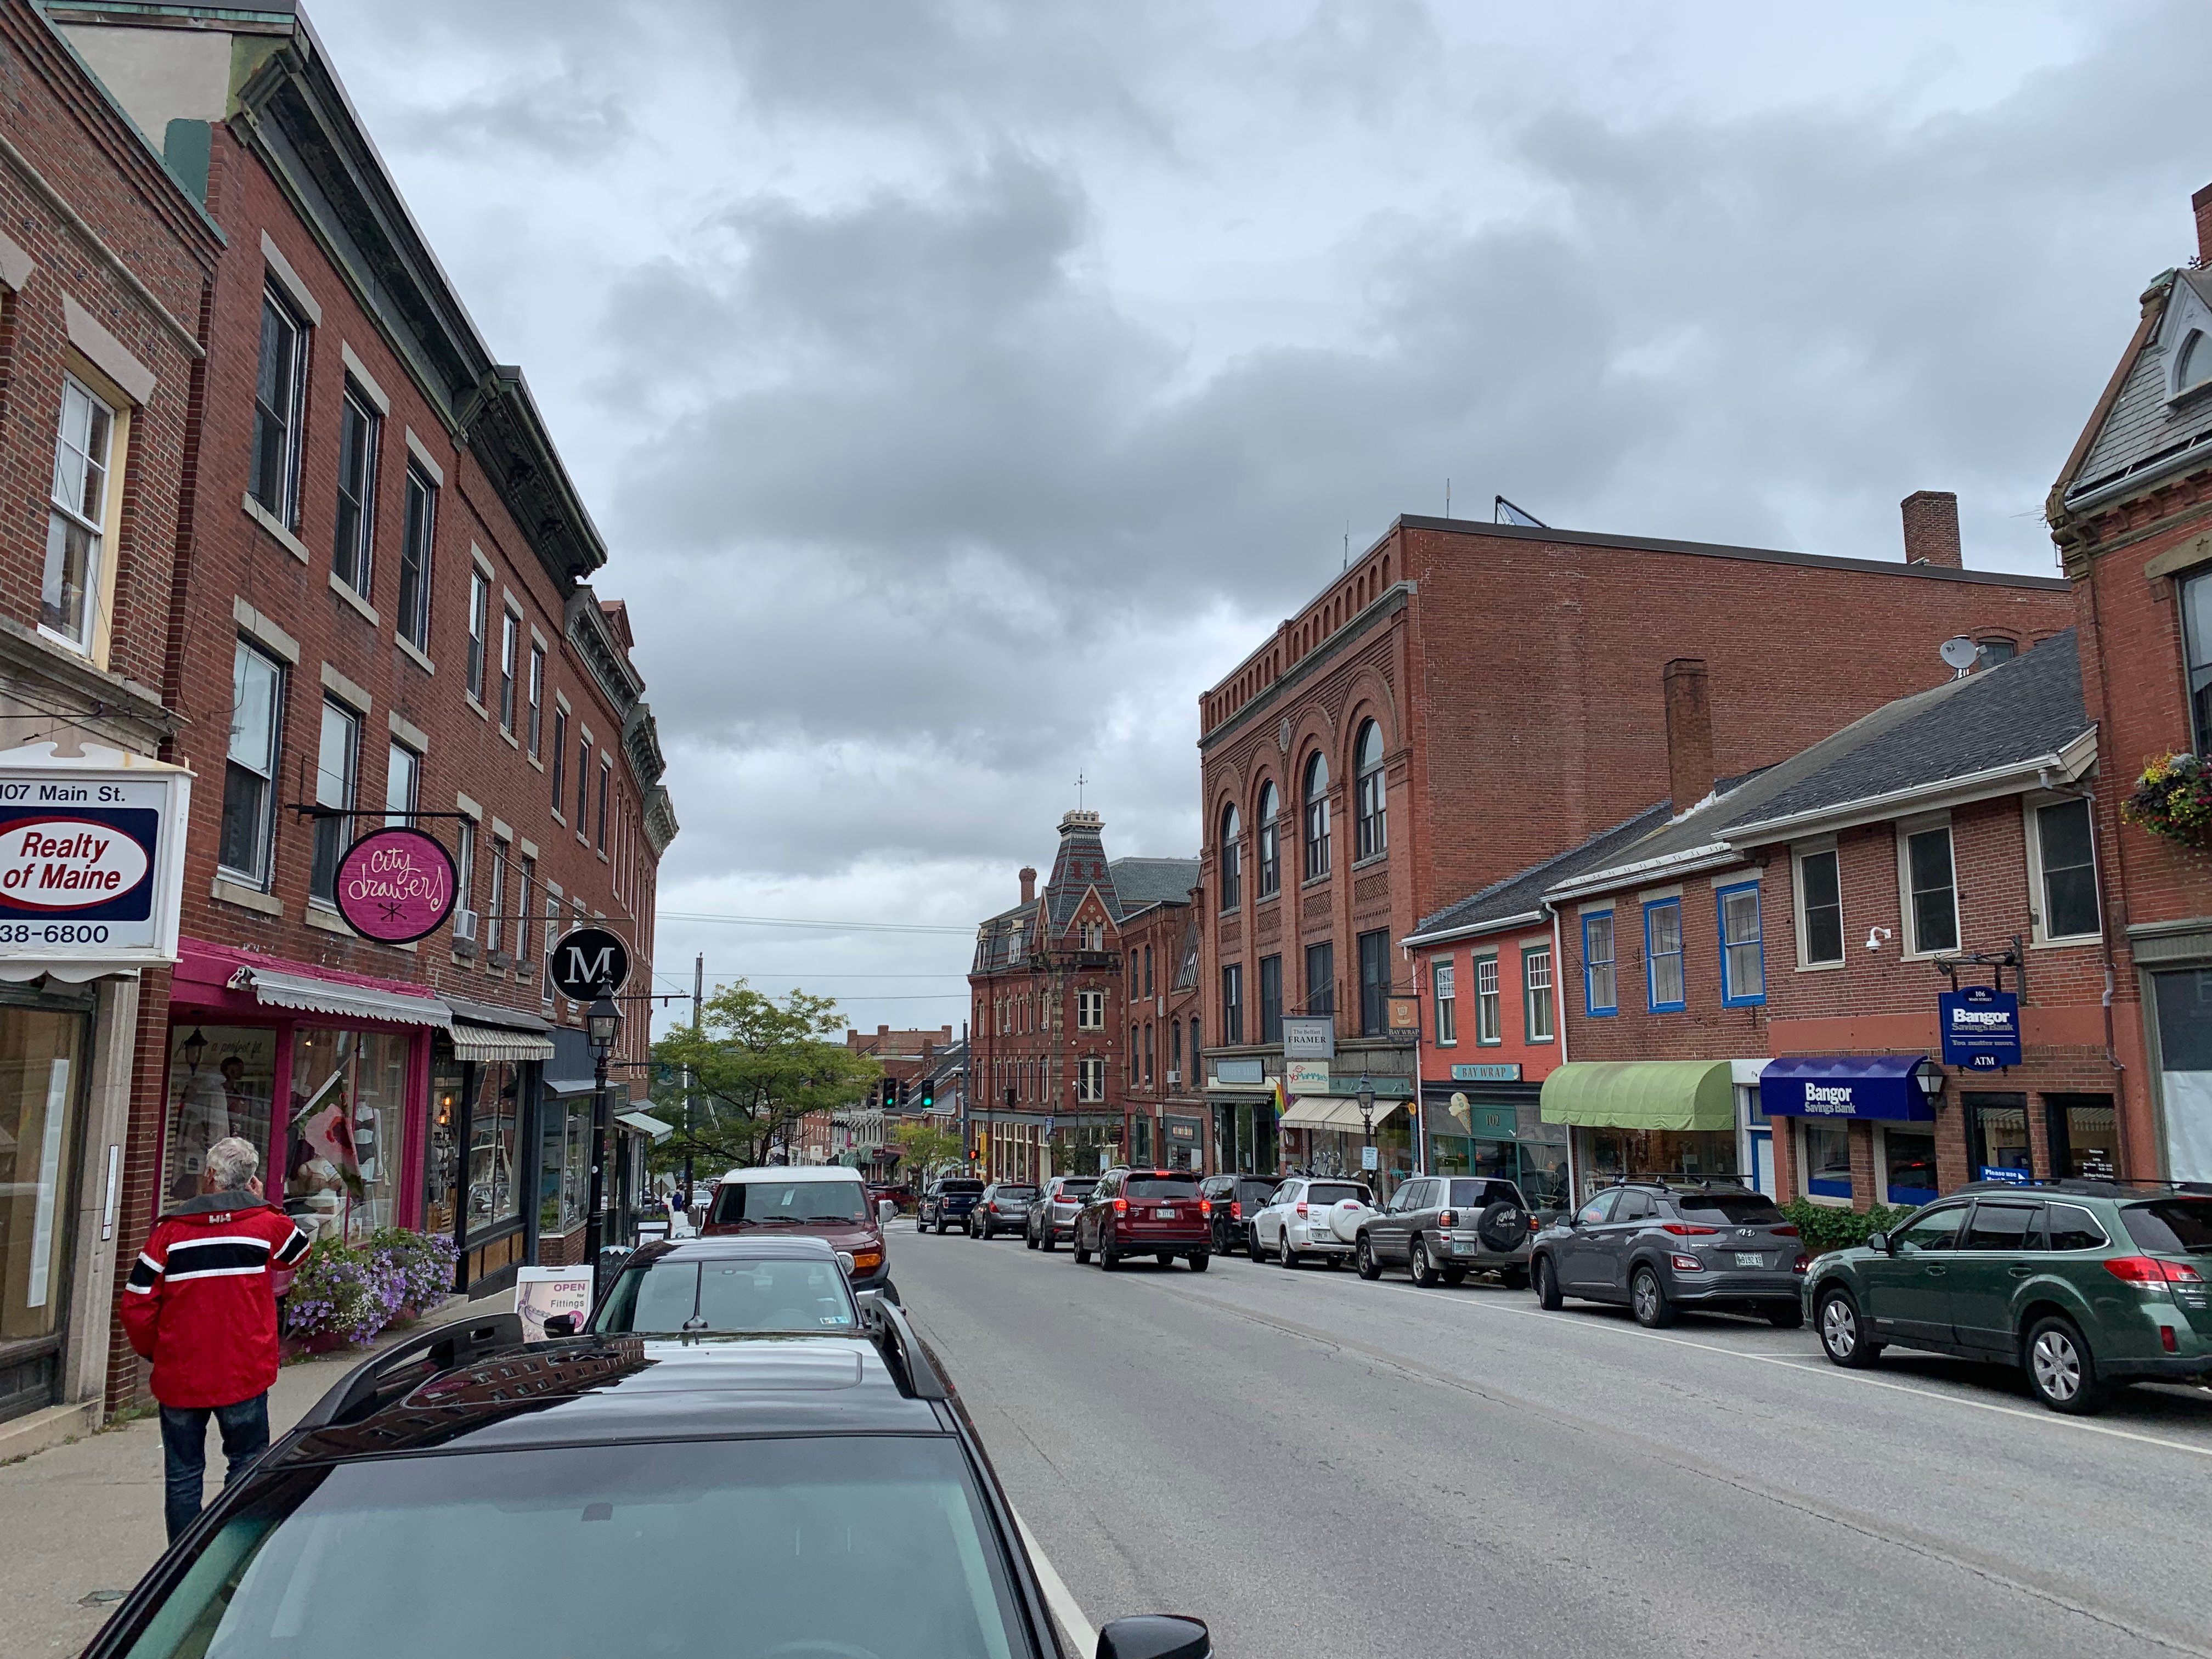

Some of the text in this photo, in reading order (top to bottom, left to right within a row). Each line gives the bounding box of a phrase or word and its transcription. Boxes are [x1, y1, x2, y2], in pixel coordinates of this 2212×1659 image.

[40, 785, 88, 801] Main
[98, 786, 126, 802] St.
[20, 832, 110, 864] Realty
[3, 863, 121, 890] of Maine
[564, 946, 615, 983] M
[1953, 1008, 2010, 1025] Bangor
[1951, 1023, 2013, 1032] Savings Bank
[1974, 1057, 1995, 1065] ATM
[1462, 1067, 1506, 1078] BAY WRAP
[1805, 1082, 1852, 1105] Bangor
[1804, 1101, 1856, 1115] Savings Bank
[1486, 1114, 1500, 1126] 102
[1985, 1169, 2005, 1177] Please
[554, 1283, 585, 1292] OPEN
[550, 1300, 585, 1310] Fittings
